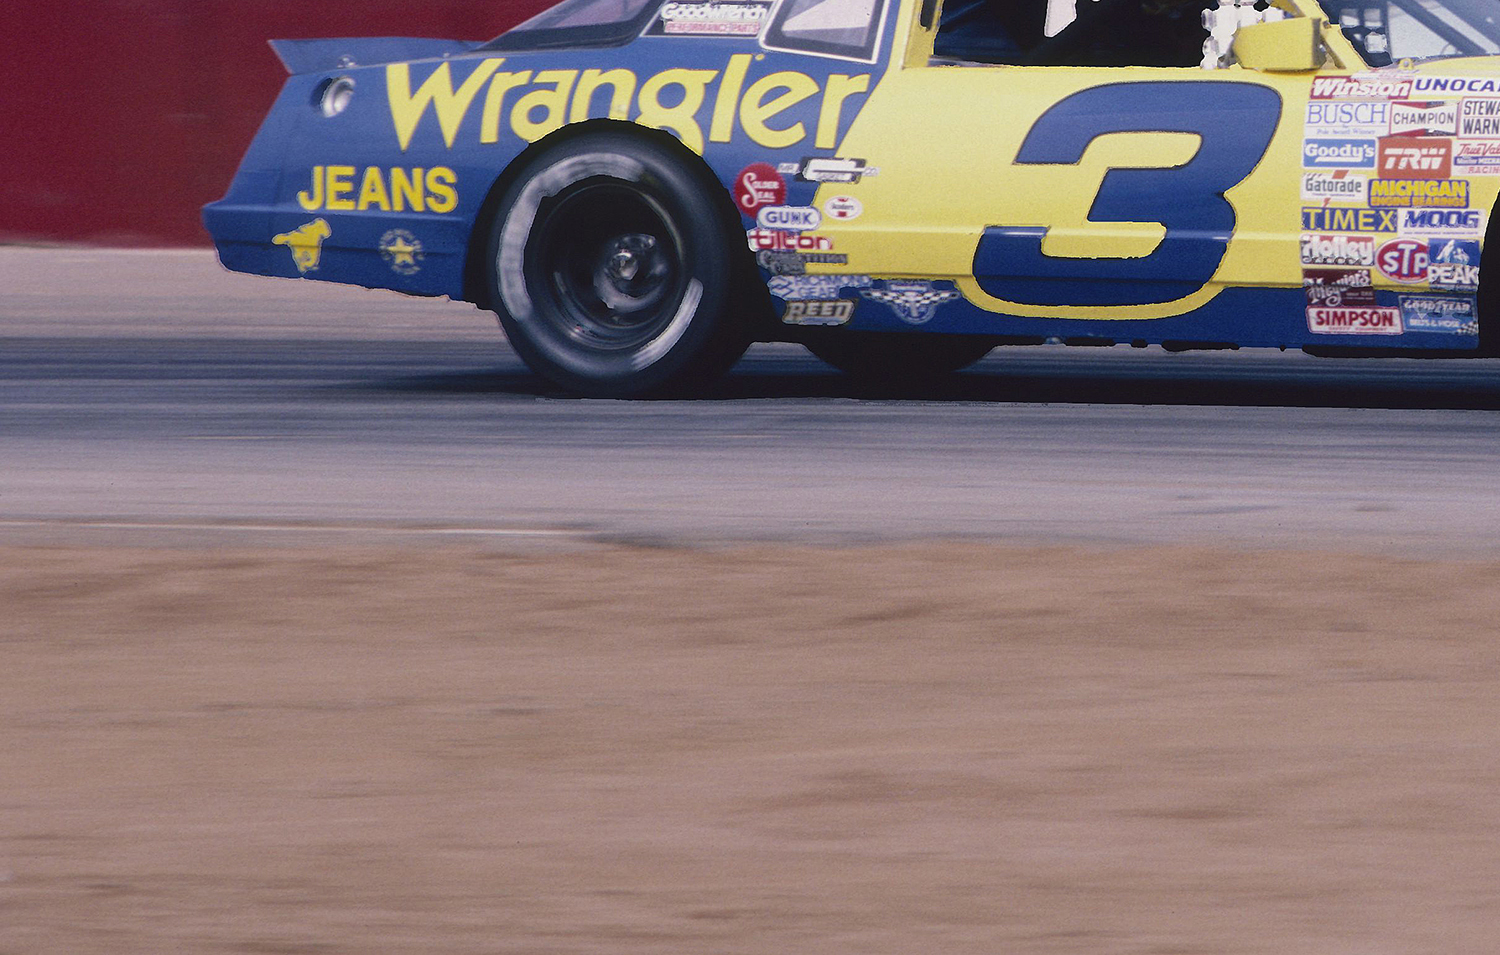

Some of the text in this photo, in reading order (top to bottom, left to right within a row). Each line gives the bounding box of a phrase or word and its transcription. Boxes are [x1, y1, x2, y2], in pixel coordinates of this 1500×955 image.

[1312, 78, 1412, 97] Winston
[386, 53, 870, 158] Wrangler
[1306, 103, 1388, 124] BUSCH
[1393, 111, 1454, 125] CHAMPION
[1305, 143, 1375, 162] Goody's
[1384, 147, 1447, 170] TRW
[297, 165, 459, 214] JEANS
[972, 80, 1284, 308] 3
[1306, 176, 1362, 193] Gatorade
[1371, 180, 1467, 197] MICHIGAN
[1371, 196, 1411, 207] ENGINE
[765, 210, 813, 225] GUNK
[1303, 209, 1395, 231] TIMEX
[1404, 210, 1479, 229] MOOG
[1301, 235, 1374, 266] Holley
[1382, 243, 1429, 275] STP
[1427, 265, 1480, 285] PEAK
[1316, 310, 1394, 327] SIMPSON
